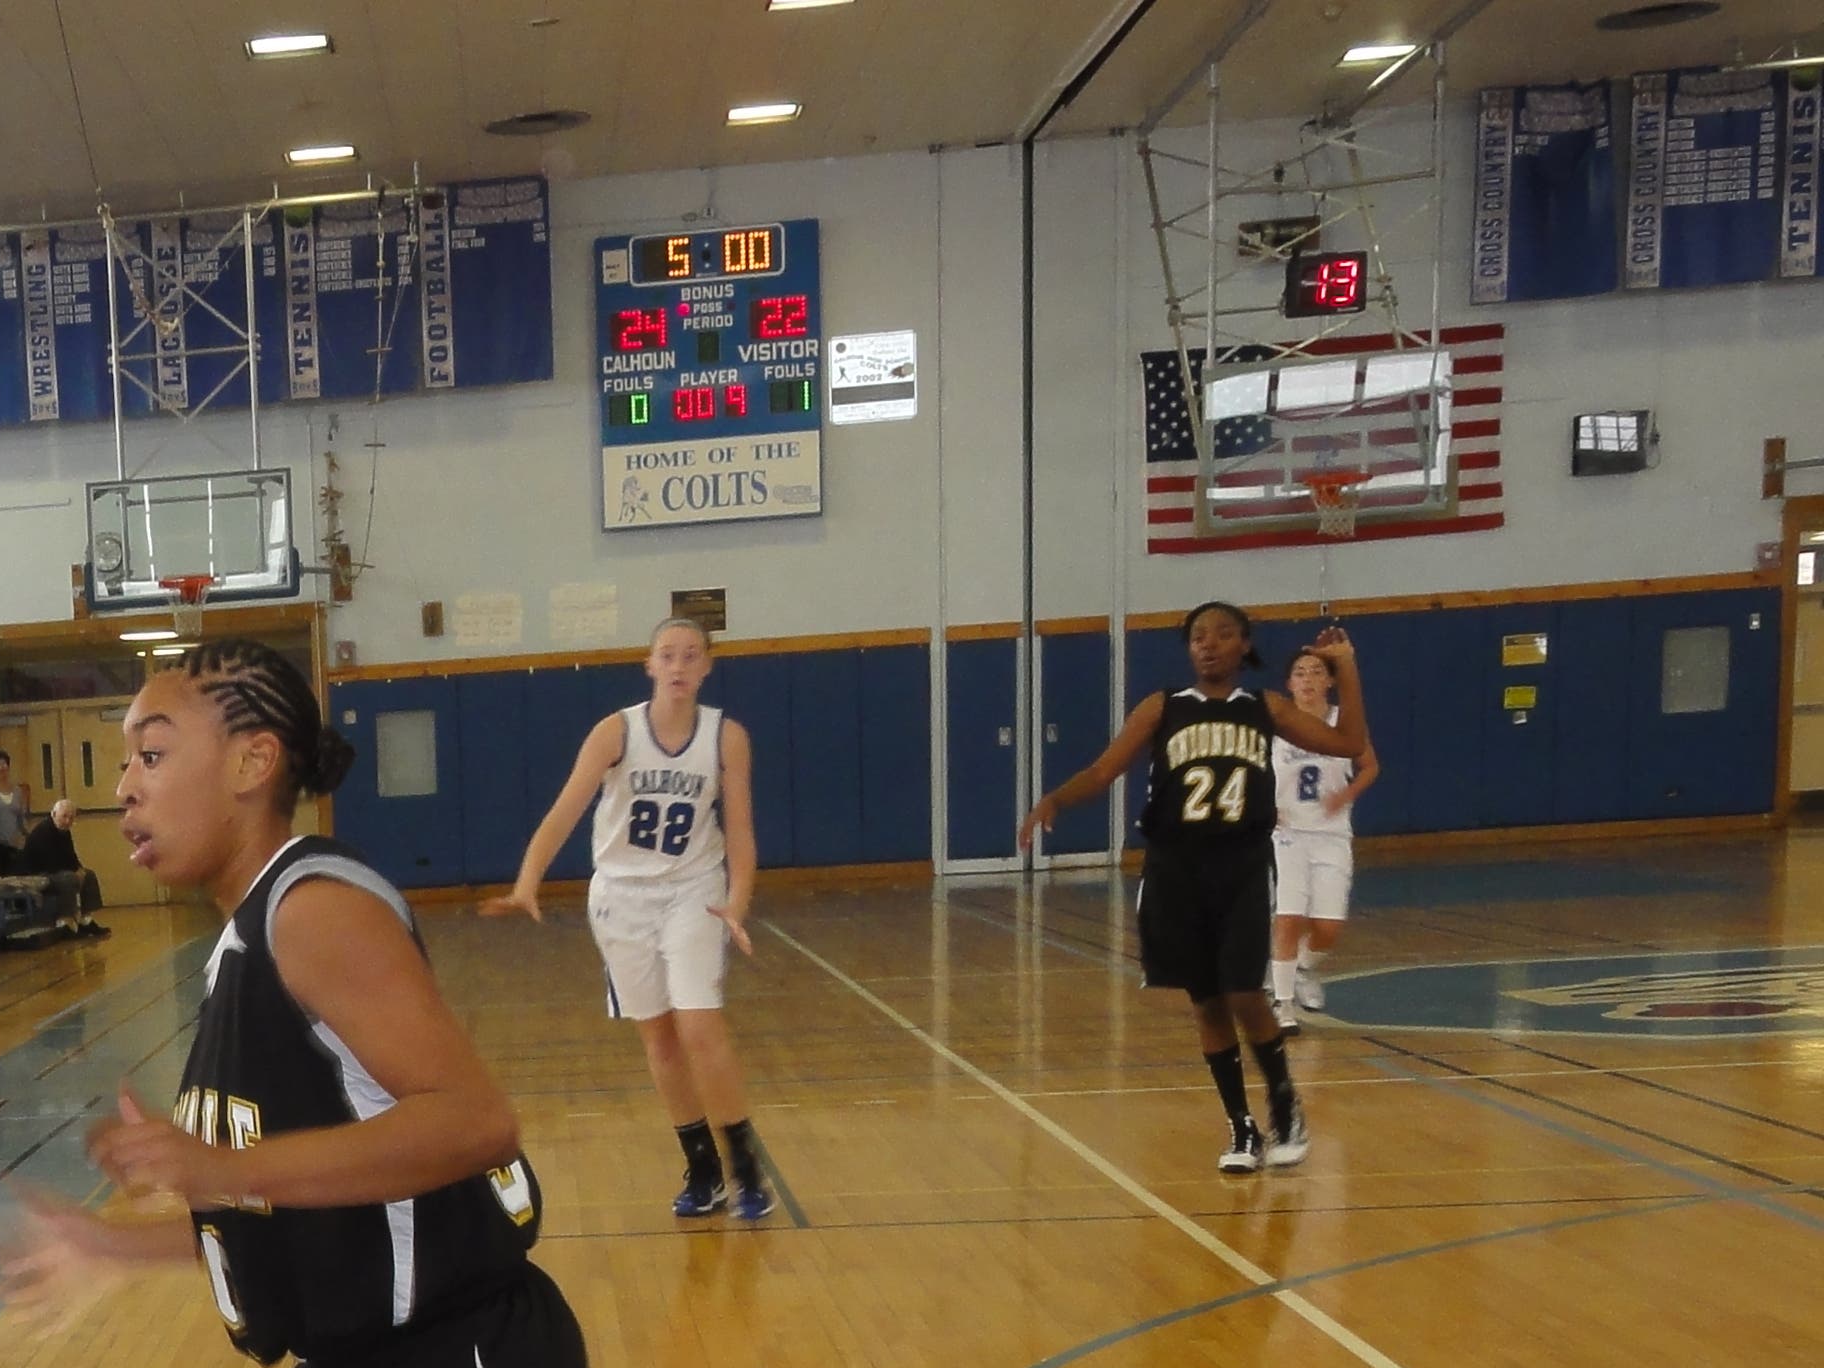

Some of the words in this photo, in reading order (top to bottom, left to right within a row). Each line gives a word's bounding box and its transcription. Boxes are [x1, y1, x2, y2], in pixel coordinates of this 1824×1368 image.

[1483, 126, 1506, 211] COUNTRY
[1636, 110, 1660, 196] COUNTRY
[1788, 97, 1816, 251] TENNIS
[1480, 218, 1503, 277] CROSS
[1632, 204, 1656, 264] CROSS
[290, 233, 314, 375] TENNIS
[425, 212, 449, 384] FOOTBALL
[680, 284, 735, 301] BONUS
[1317, 261, 1358, 305] 13
[620, 308, 667, 350] 24
[683, 315, 733, 330] PERIOD
[692, 302, 723, 314] POSS
[759, 295, 808, 336] 22
[27, 263, 52, 397] WRESTLING
[738, 339, 819, 363] VISITOR
[603, 351, 675, 374] CALHOUN
[680, 368, 738, 387] PLAYER
[764, 363, 816, 380] FOULS
[603, 376, 654, 393] FOULS
[803, 381, 810, 410] 1
[631, 394, 649, 424] 0
[626, 450, 696, 471] HOME
[708, 446, 738, 464] OF
[752, 441, 801, 461] THE
[661, 470, 769, 512] COLTS
[1182, 766, 1247, 822] 24
[629, 799, 695, 856] 22
